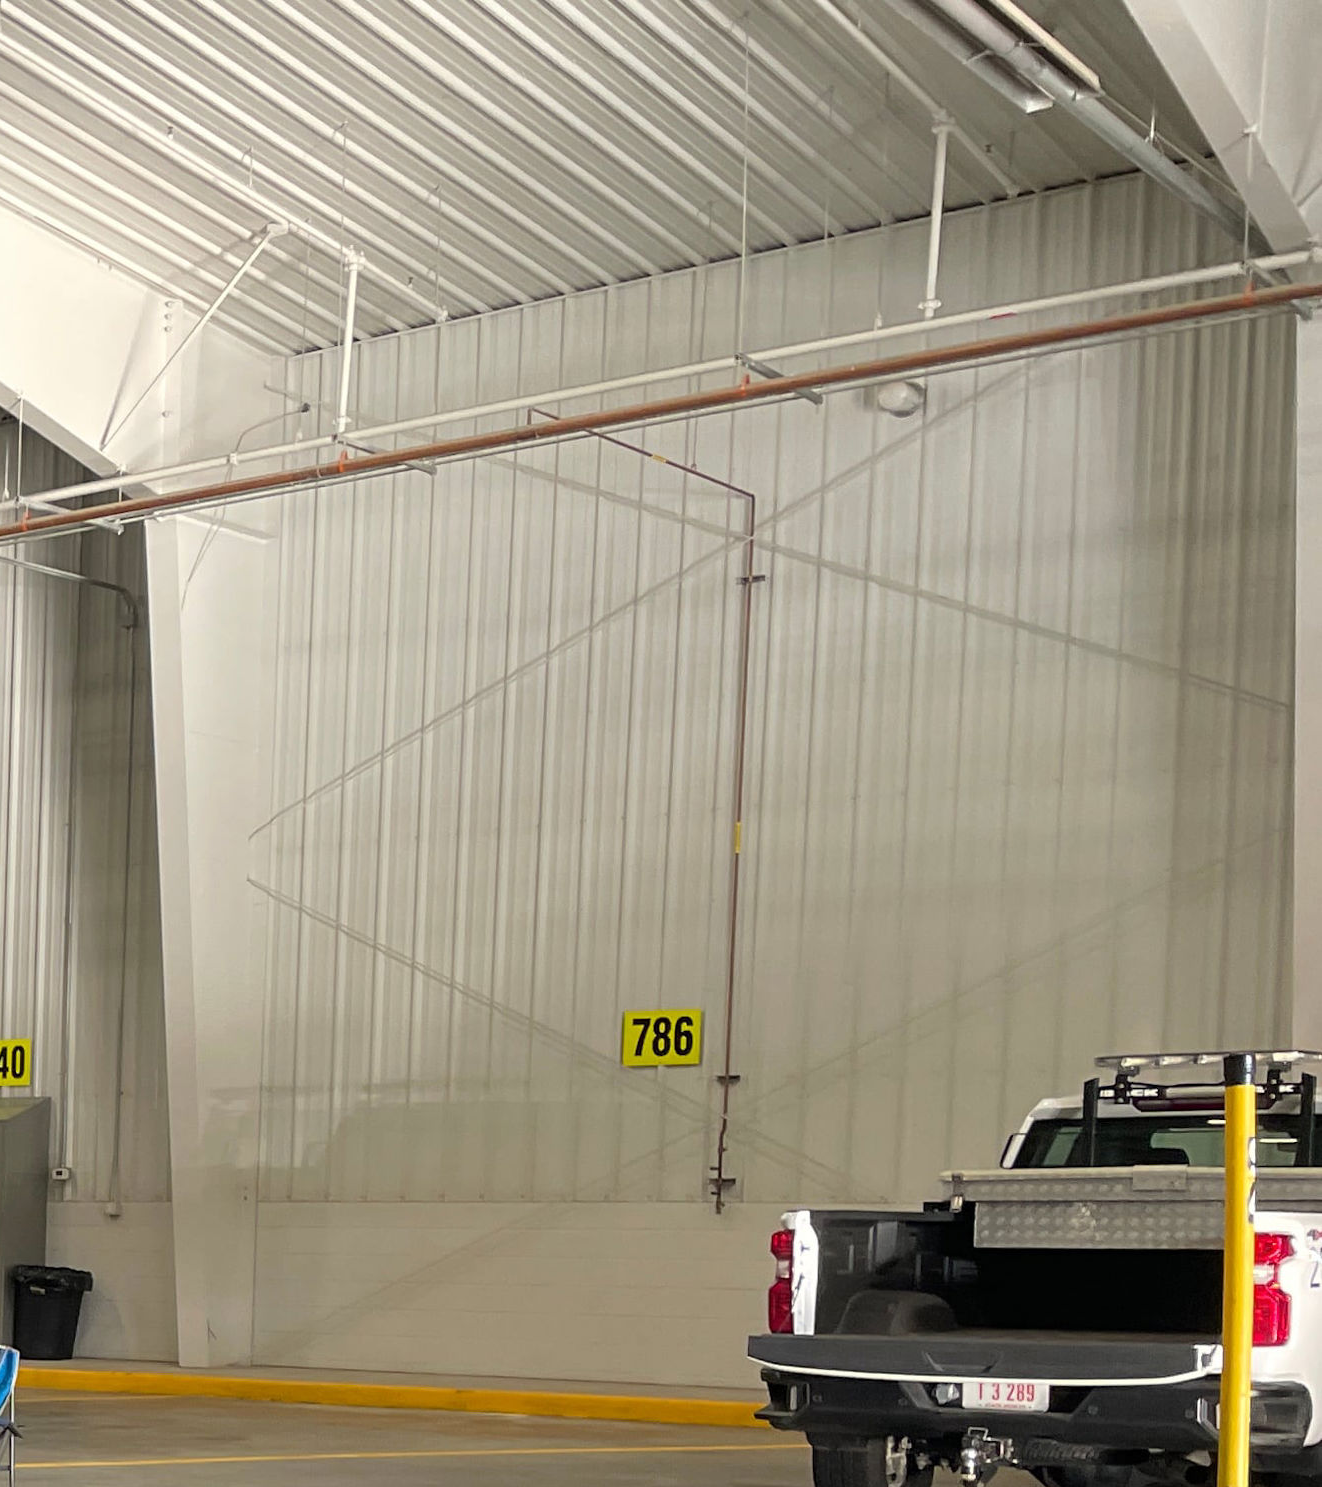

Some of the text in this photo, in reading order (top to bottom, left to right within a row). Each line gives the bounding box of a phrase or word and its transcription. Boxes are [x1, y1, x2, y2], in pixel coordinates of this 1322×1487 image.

[632, 1015, 694, 1057] 786
[991, 1382, 1000, 1401] 3
[1006, 1383, 1036, 1402] 289
